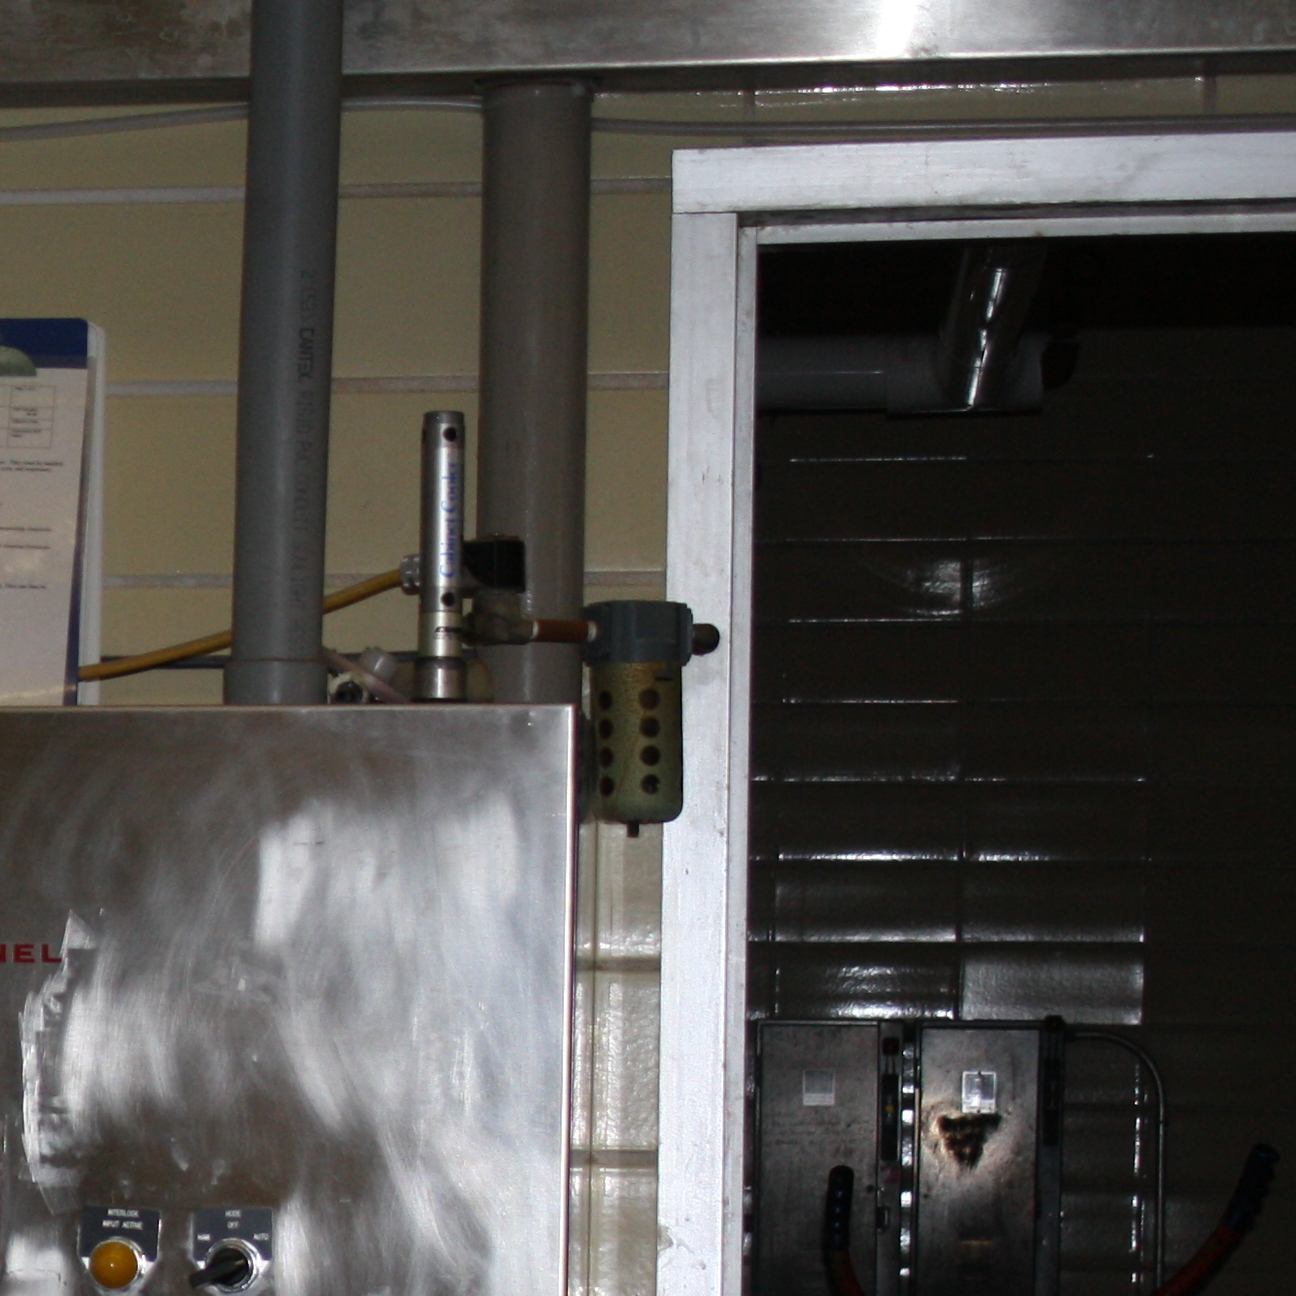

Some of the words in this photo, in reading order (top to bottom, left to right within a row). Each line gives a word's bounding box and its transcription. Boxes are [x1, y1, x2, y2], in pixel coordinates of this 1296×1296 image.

[108, 1208, 139, 1218] INTERLOCK
[102, 1219, 120, 1229] INPUT
[253, 1233, 269, 1242] AUTO
